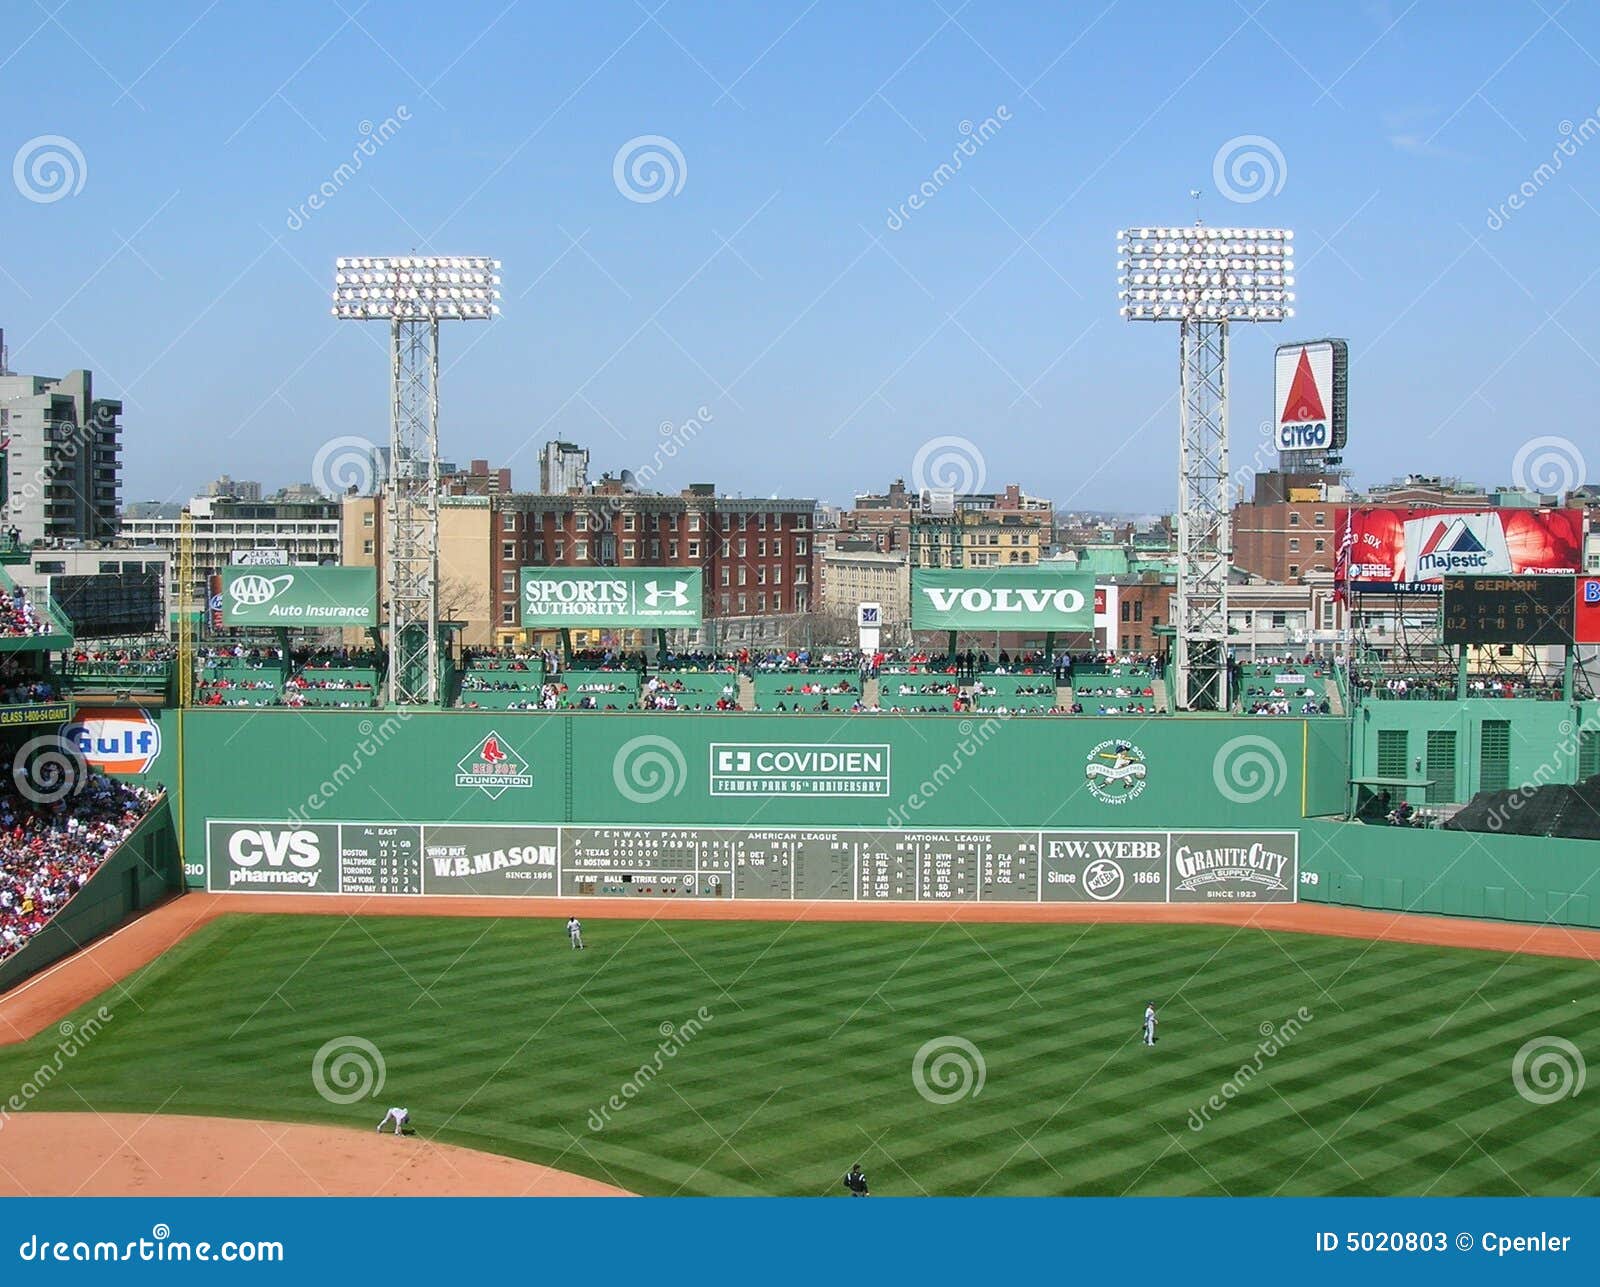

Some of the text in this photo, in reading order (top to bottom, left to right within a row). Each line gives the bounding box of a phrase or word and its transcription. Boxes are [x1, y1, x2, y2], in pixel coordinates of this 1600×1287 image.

[1281, 423, 1326, 448] CITGO
[1363, 533, 1381, 549] SOX
[1419, 553, 1488, 571] Majestic
[235, 576, 270, 603] AAA
[525, 580, 628, 602] SPORTS
[1394, 583, 1411, 591] THE
[1474, 580, 1537, 591] GERMAN
[923, 588, 1085, 612] VOLVO
[269, 604, 369, 617] Auto Insurance
[66, 727, 153, 754] Gulf
[757, 752, 881, 772] COVIDIEN
[459, 777, 528, 785] FOUNDATION
[718, 781, 758, 791] FENWAY
[761, 781, 787, 791] PARK
[812, 781, 881, 792] ANNIVERSARY
[379, 840, 389, 848] W
[904, 834, 950, 842] NATIONAL
[229, 829, 320, 867] CVS
[342, 849, 368, 857] BOSTON
[1092, 841, 1161, 859] WEBB
[342, 858, 377, 866] BALTIMORE
[583, 858, 611, 866] BOSTON
[184, 864, 204, 876] 310
[343, 867, 372, 875] TORONTO
[229, 868, 318, 887] pharmacy
[342, 876, 357, 884] NEW
[631, 875, 657, 883] STRIKE
[660, 876, 677, 884] OUT
[996, 876, 1013, 884] COL
[1047, 871, 1076, 884] Since
[1132, 872, 1160, 884] 1866
[1300, 872, 1319, 885] 379
